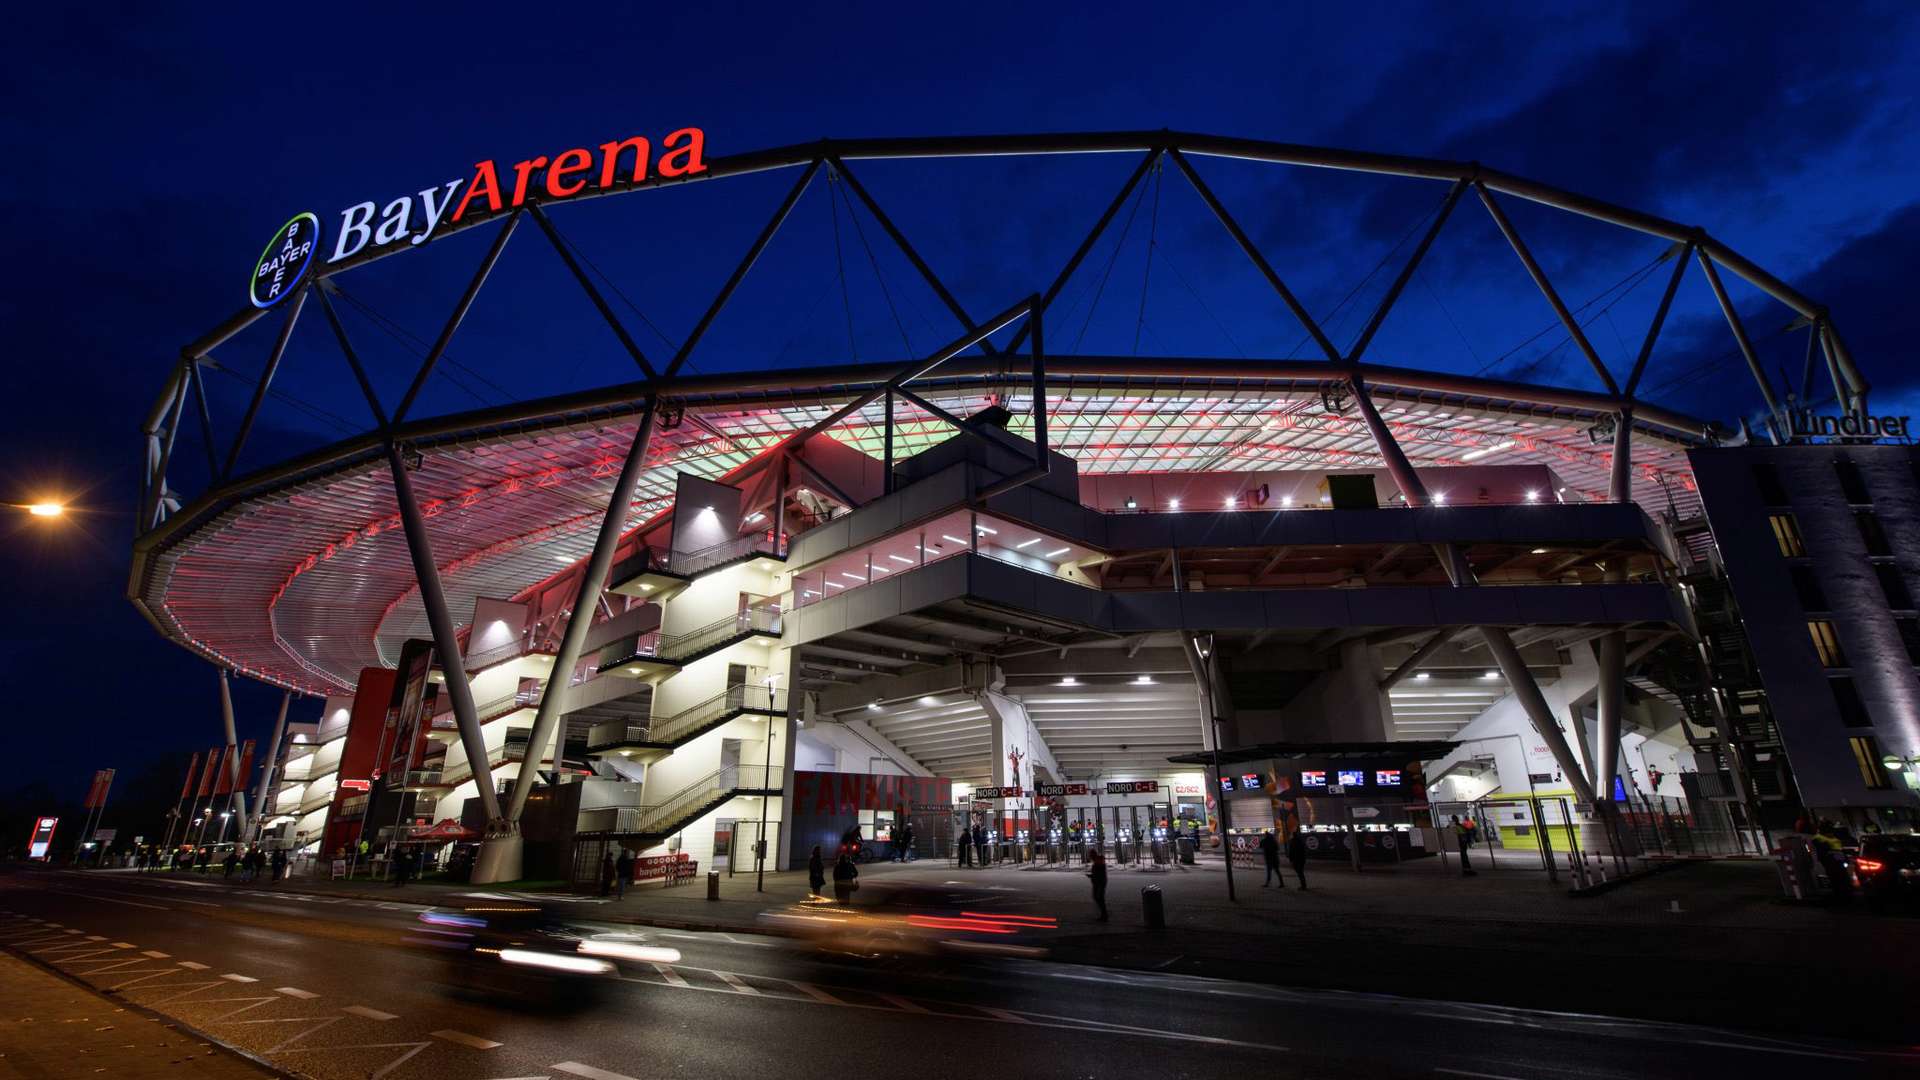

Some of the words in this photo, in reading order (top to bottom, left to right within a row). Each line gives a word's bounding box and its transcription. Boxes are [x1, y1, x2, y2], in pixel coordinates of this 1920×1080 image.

[327, 126, 707, 264] BayArena
[258, 240, 311, 277] BAYER
[268, 222, 299, 298] BAYER
[977, 788, 998, 798] NORD
[1041, 785, 1064, 796] NORD
[1066, 784, 1085, 794] C-E
[1108, 783, 1132, 793] NORD
[1135, 782, 1155, 792] C-E
